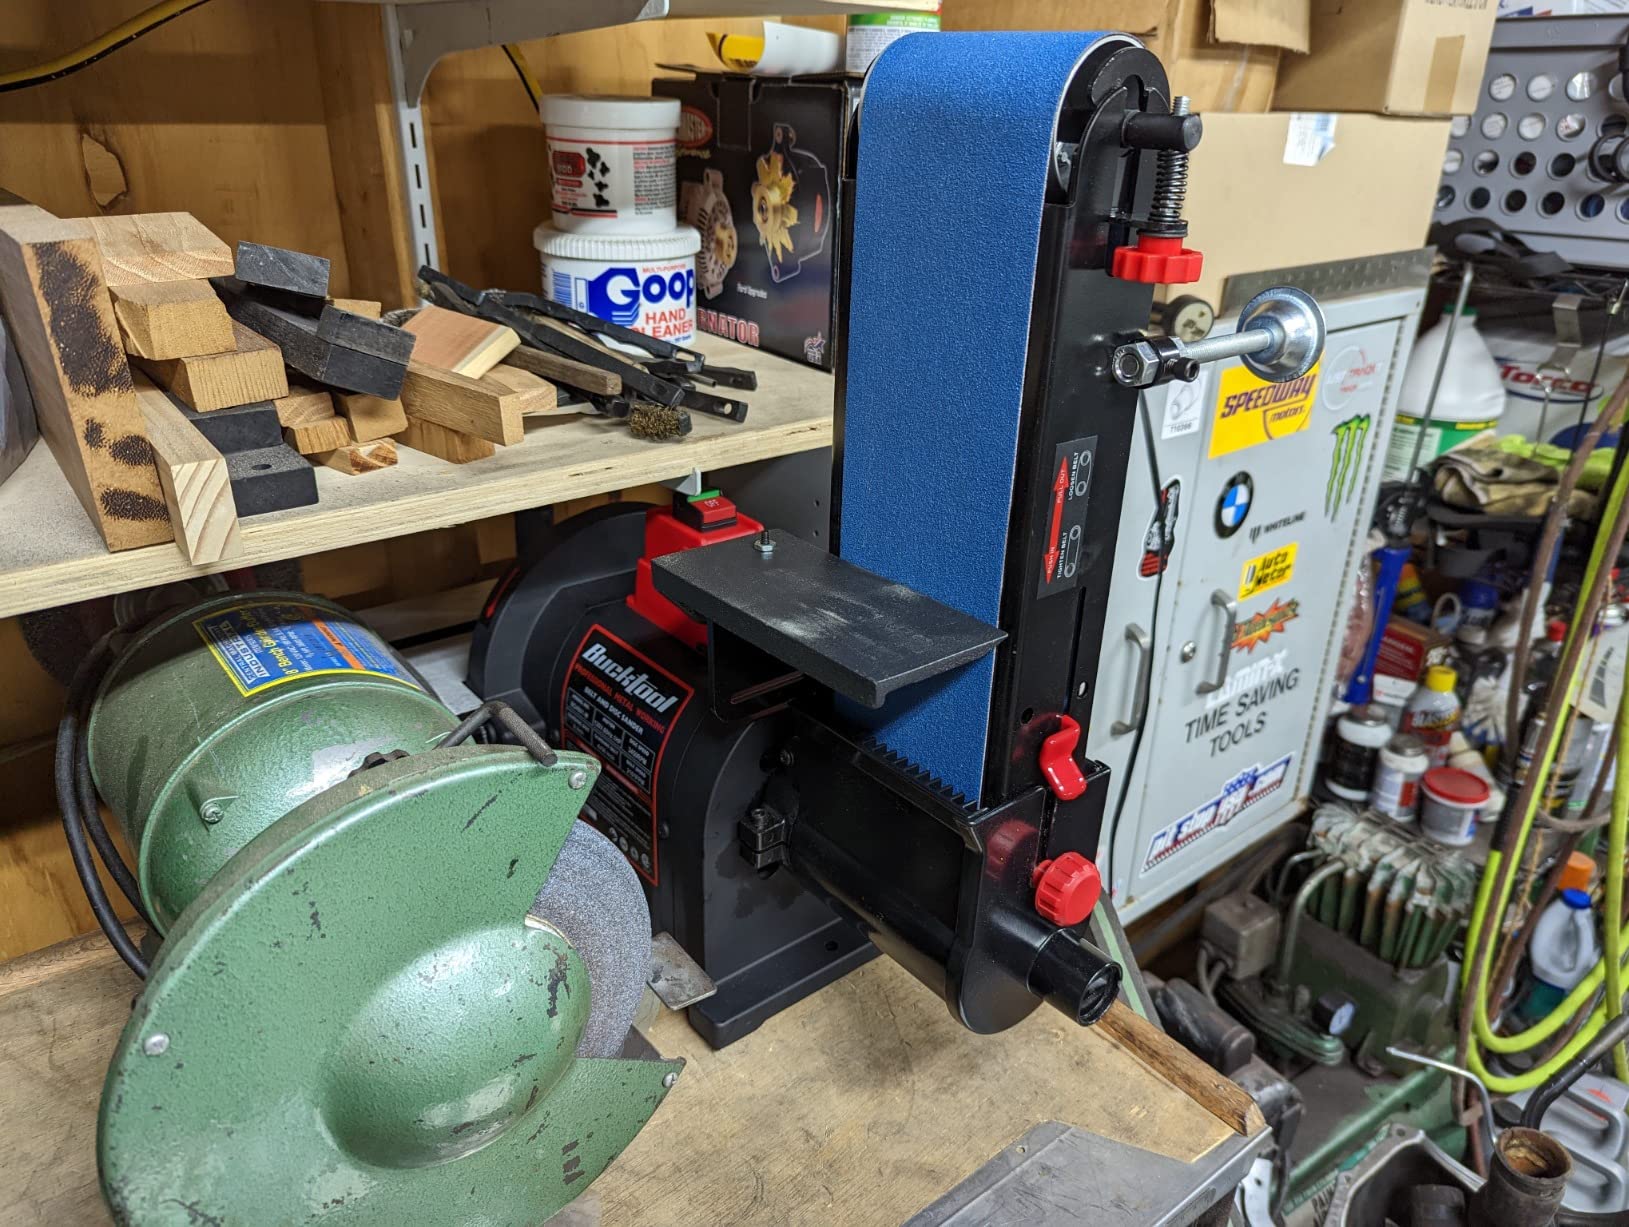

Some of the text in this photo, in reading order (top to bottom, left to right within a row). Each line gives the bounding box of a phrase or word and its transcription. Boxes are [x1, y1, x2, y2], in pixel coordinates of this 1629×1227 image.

[645, 308, 687, 326] HAND
[697, 306, 760, 347] RNATOR
[1220, 373, 1317, 419] SPEEDWAY
[1068, 471, 1076, 500] LOOSEN
[221, 622, 267, 678] INDUSTRIAL
[268, 647, 292, 668] Bench
[581, 642, 680, 713] Bucktool
[1185, 667, 1301, 744] TIME SAVING
[1209, 712, 1268, 758] TOOLS
